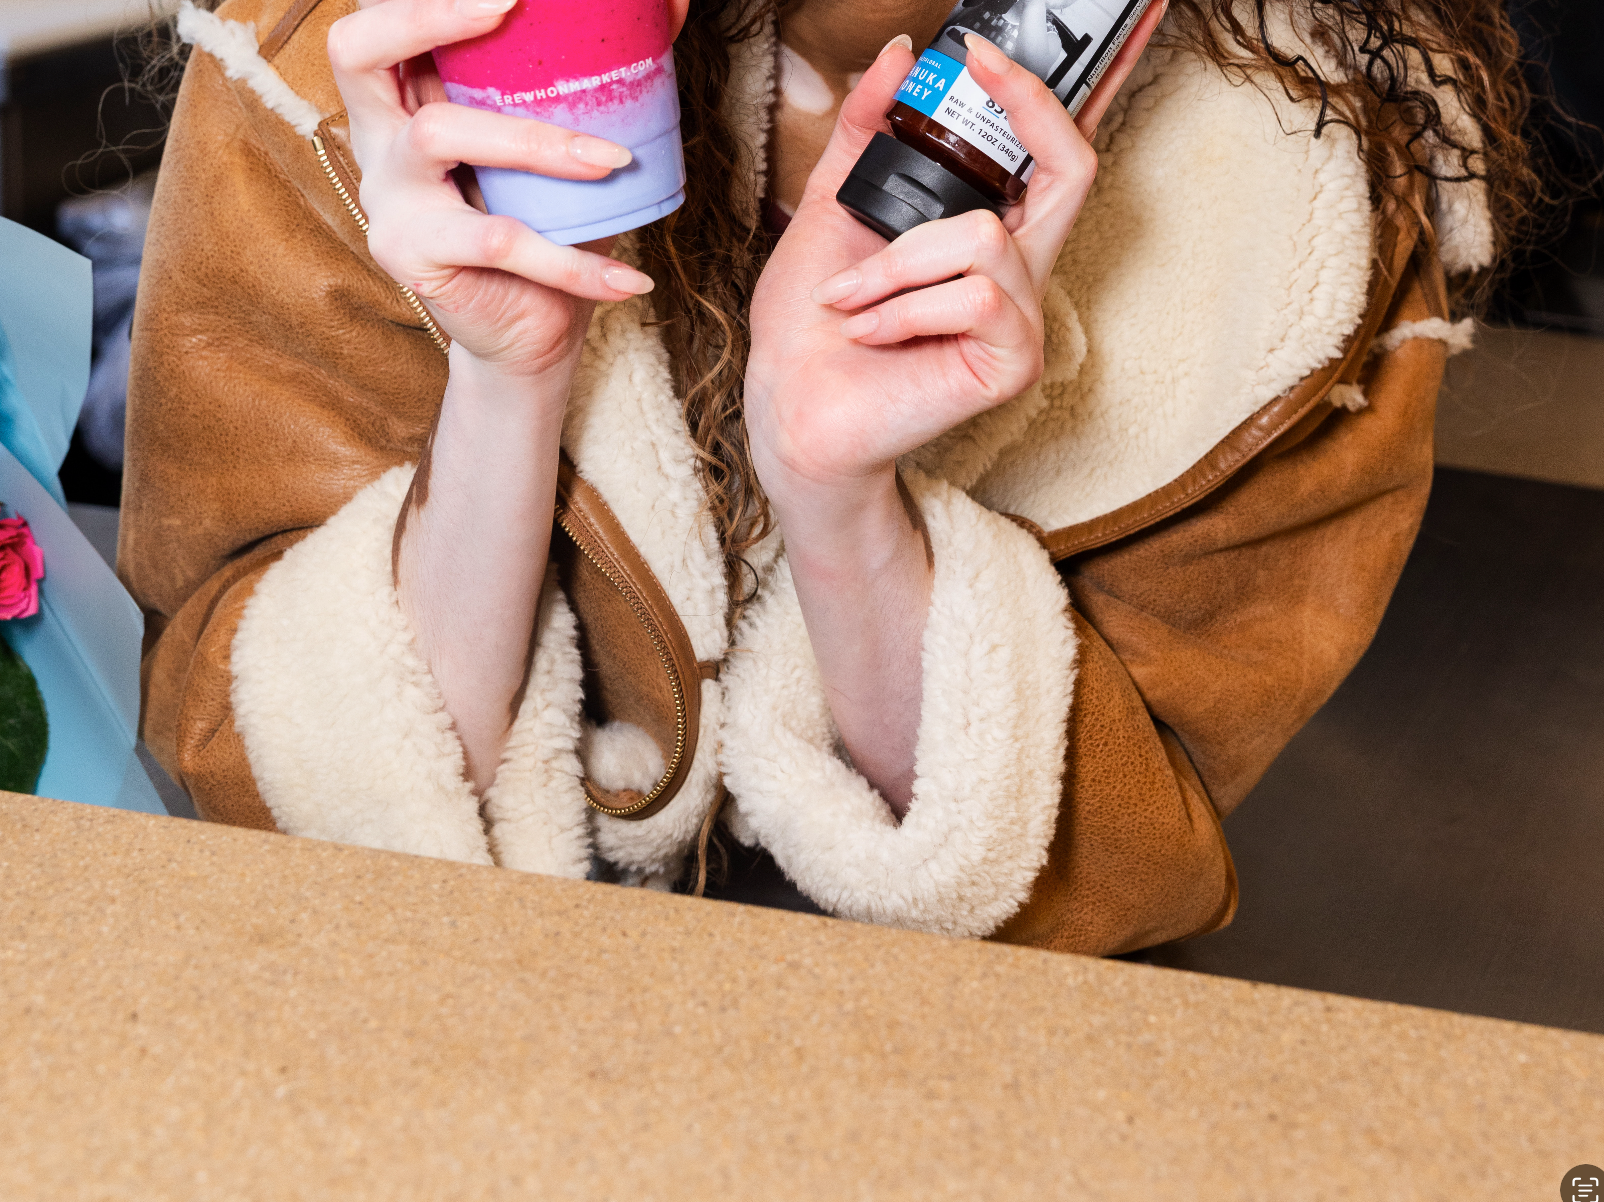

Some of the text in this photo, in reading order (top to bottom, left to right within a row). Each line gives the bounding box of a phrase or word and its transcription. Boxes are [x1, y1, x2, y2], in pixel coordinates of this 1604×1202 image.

[494, 56, 654, 107] EREWHONMARKET.COM
[900, 79, 933, 101] ONEY
[944, 106, 963, 122] NET
[961, 116, 976, 132] WT.
[996, 142, 1020, 163] (340g)
[948, 95, 967, 110] RAW
[975, 112, 1028, 154] UNPASTEURIZED
